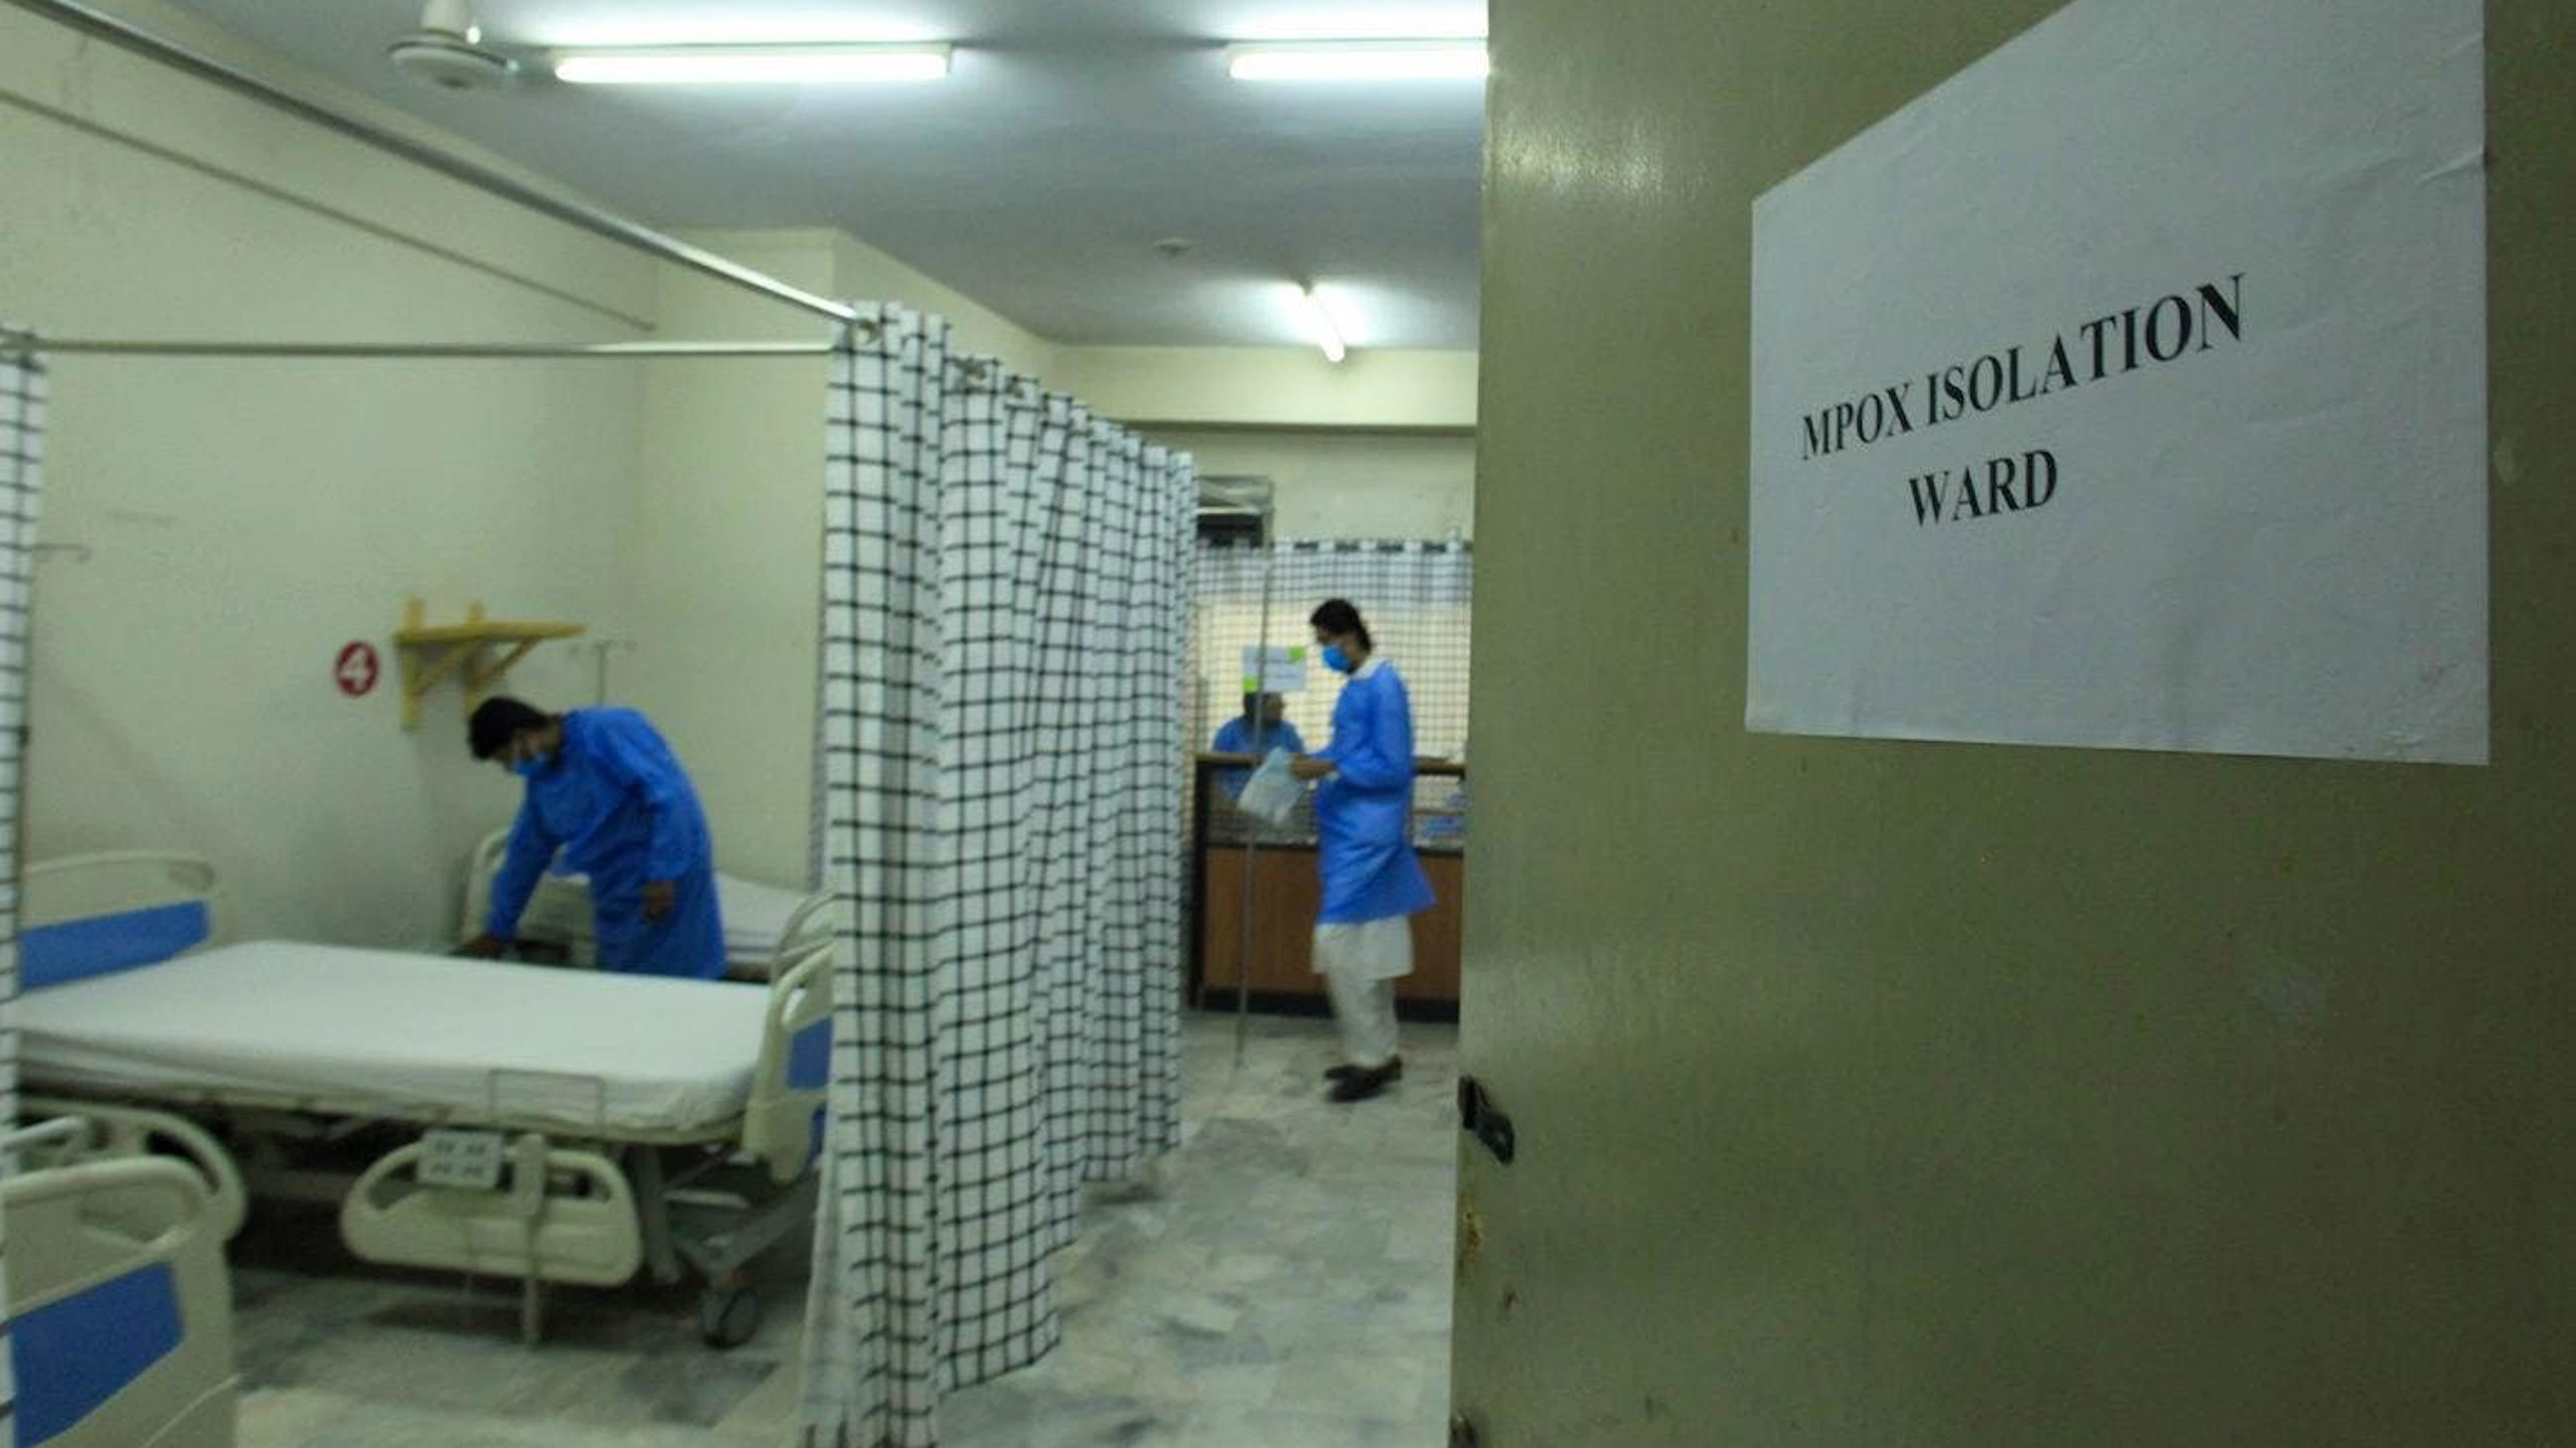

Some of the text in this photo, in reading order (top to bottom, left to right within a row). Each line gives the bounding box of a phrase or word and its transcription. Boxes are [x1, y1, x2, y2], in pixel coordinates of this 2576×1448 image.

[1803, 273, 2245, 460] MPOX ISOLATION
[1908, 449, 2057, 527] WARD
[341, 645, 372, 691] 4
